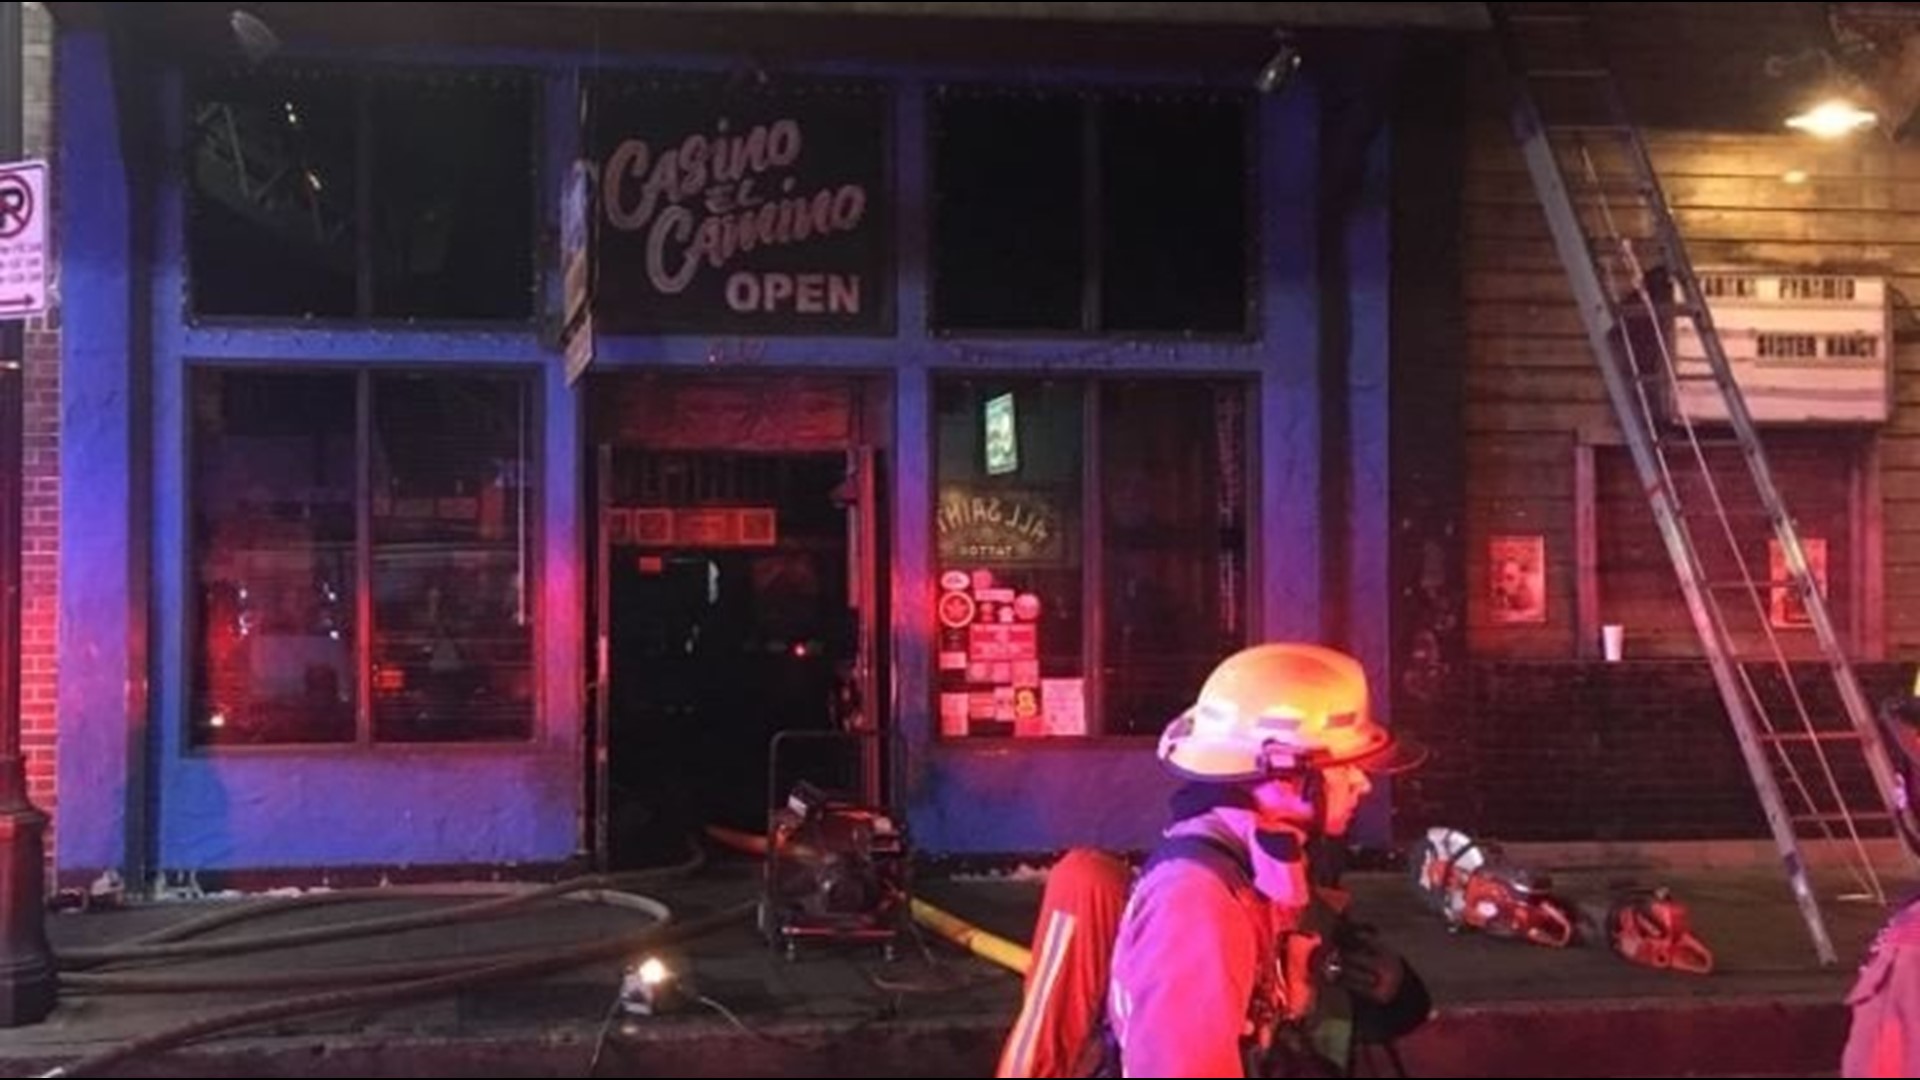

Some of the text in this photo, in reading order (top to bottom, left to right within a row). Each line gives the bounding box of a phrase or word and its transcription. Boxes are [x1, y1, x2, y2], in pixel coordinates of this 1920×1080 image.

[646, 178, 865, 293] Camino
[726, 271, 860, 313] OPEN
[1757, 334, 1879, 358] SISTER NANCY
